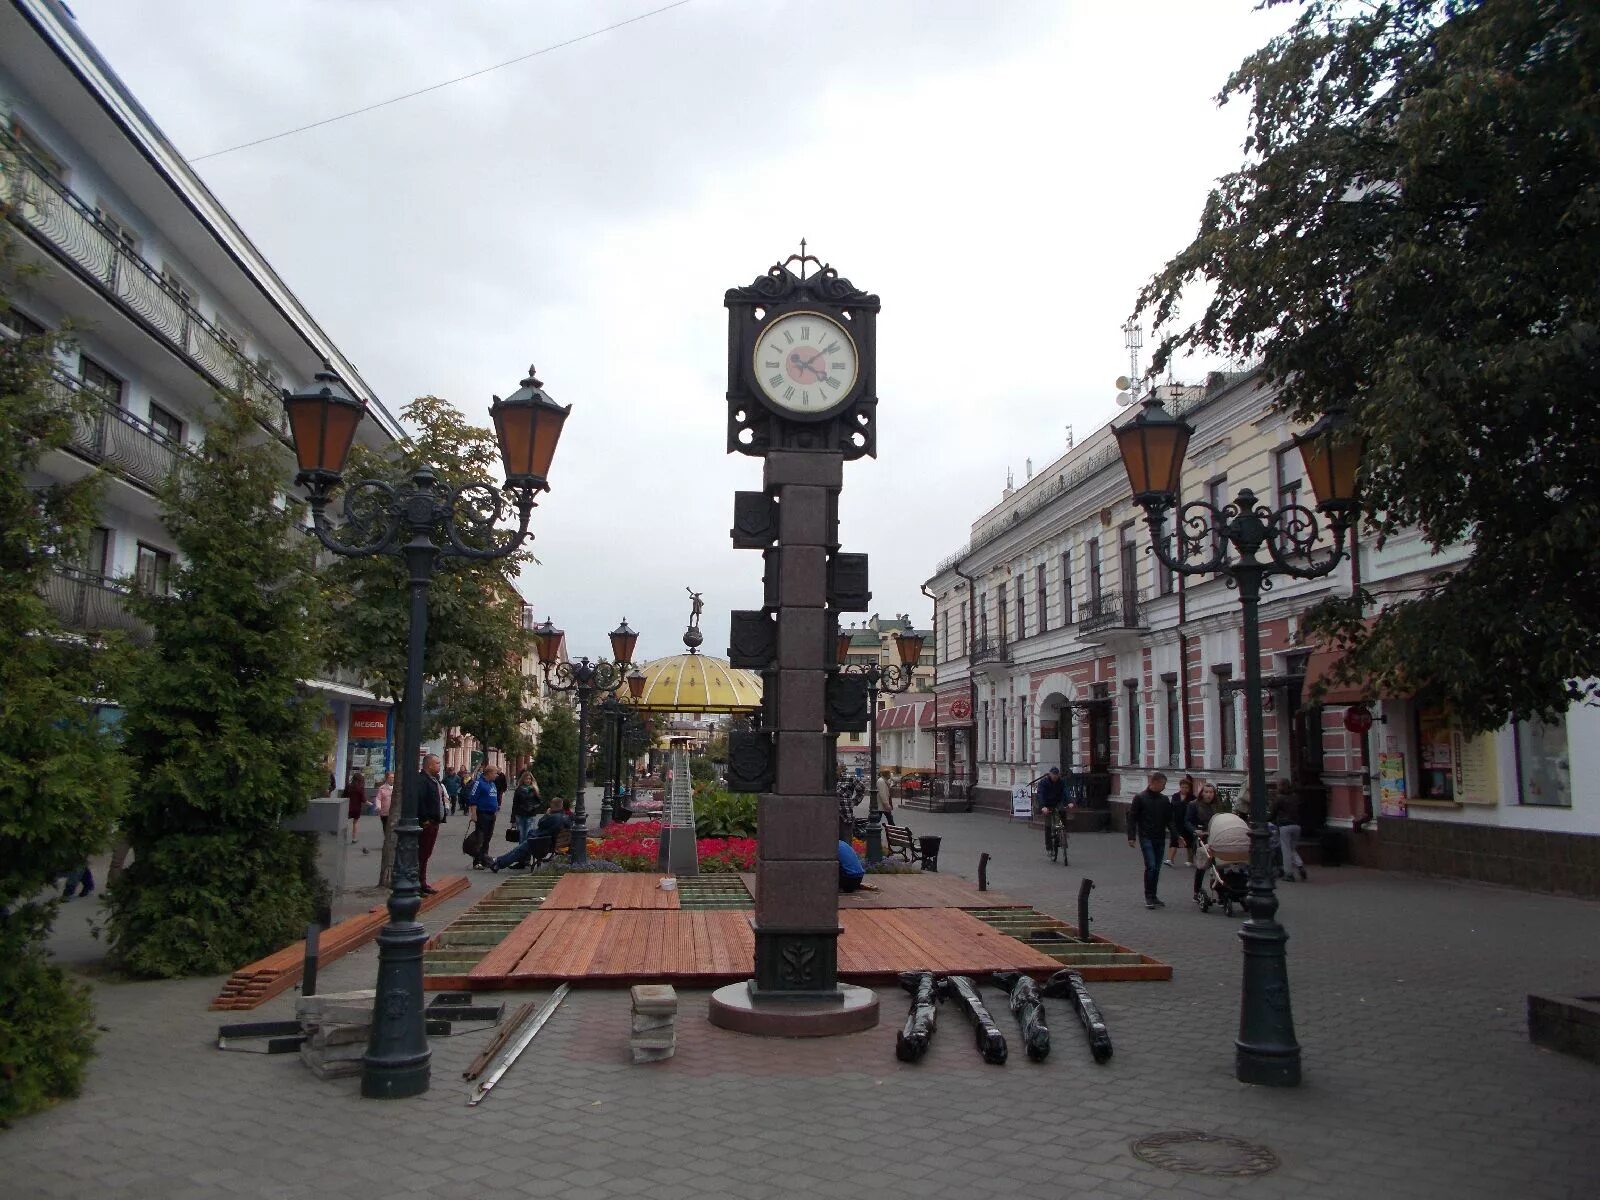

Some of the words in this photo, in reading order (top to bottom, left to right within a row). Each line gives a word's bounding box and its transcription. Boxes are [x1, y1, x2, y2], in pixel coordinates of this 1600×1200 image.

[801, 326, 810, 341] XII
[818, 332, 826, 344] I
[832, 362, 846, 370] III
